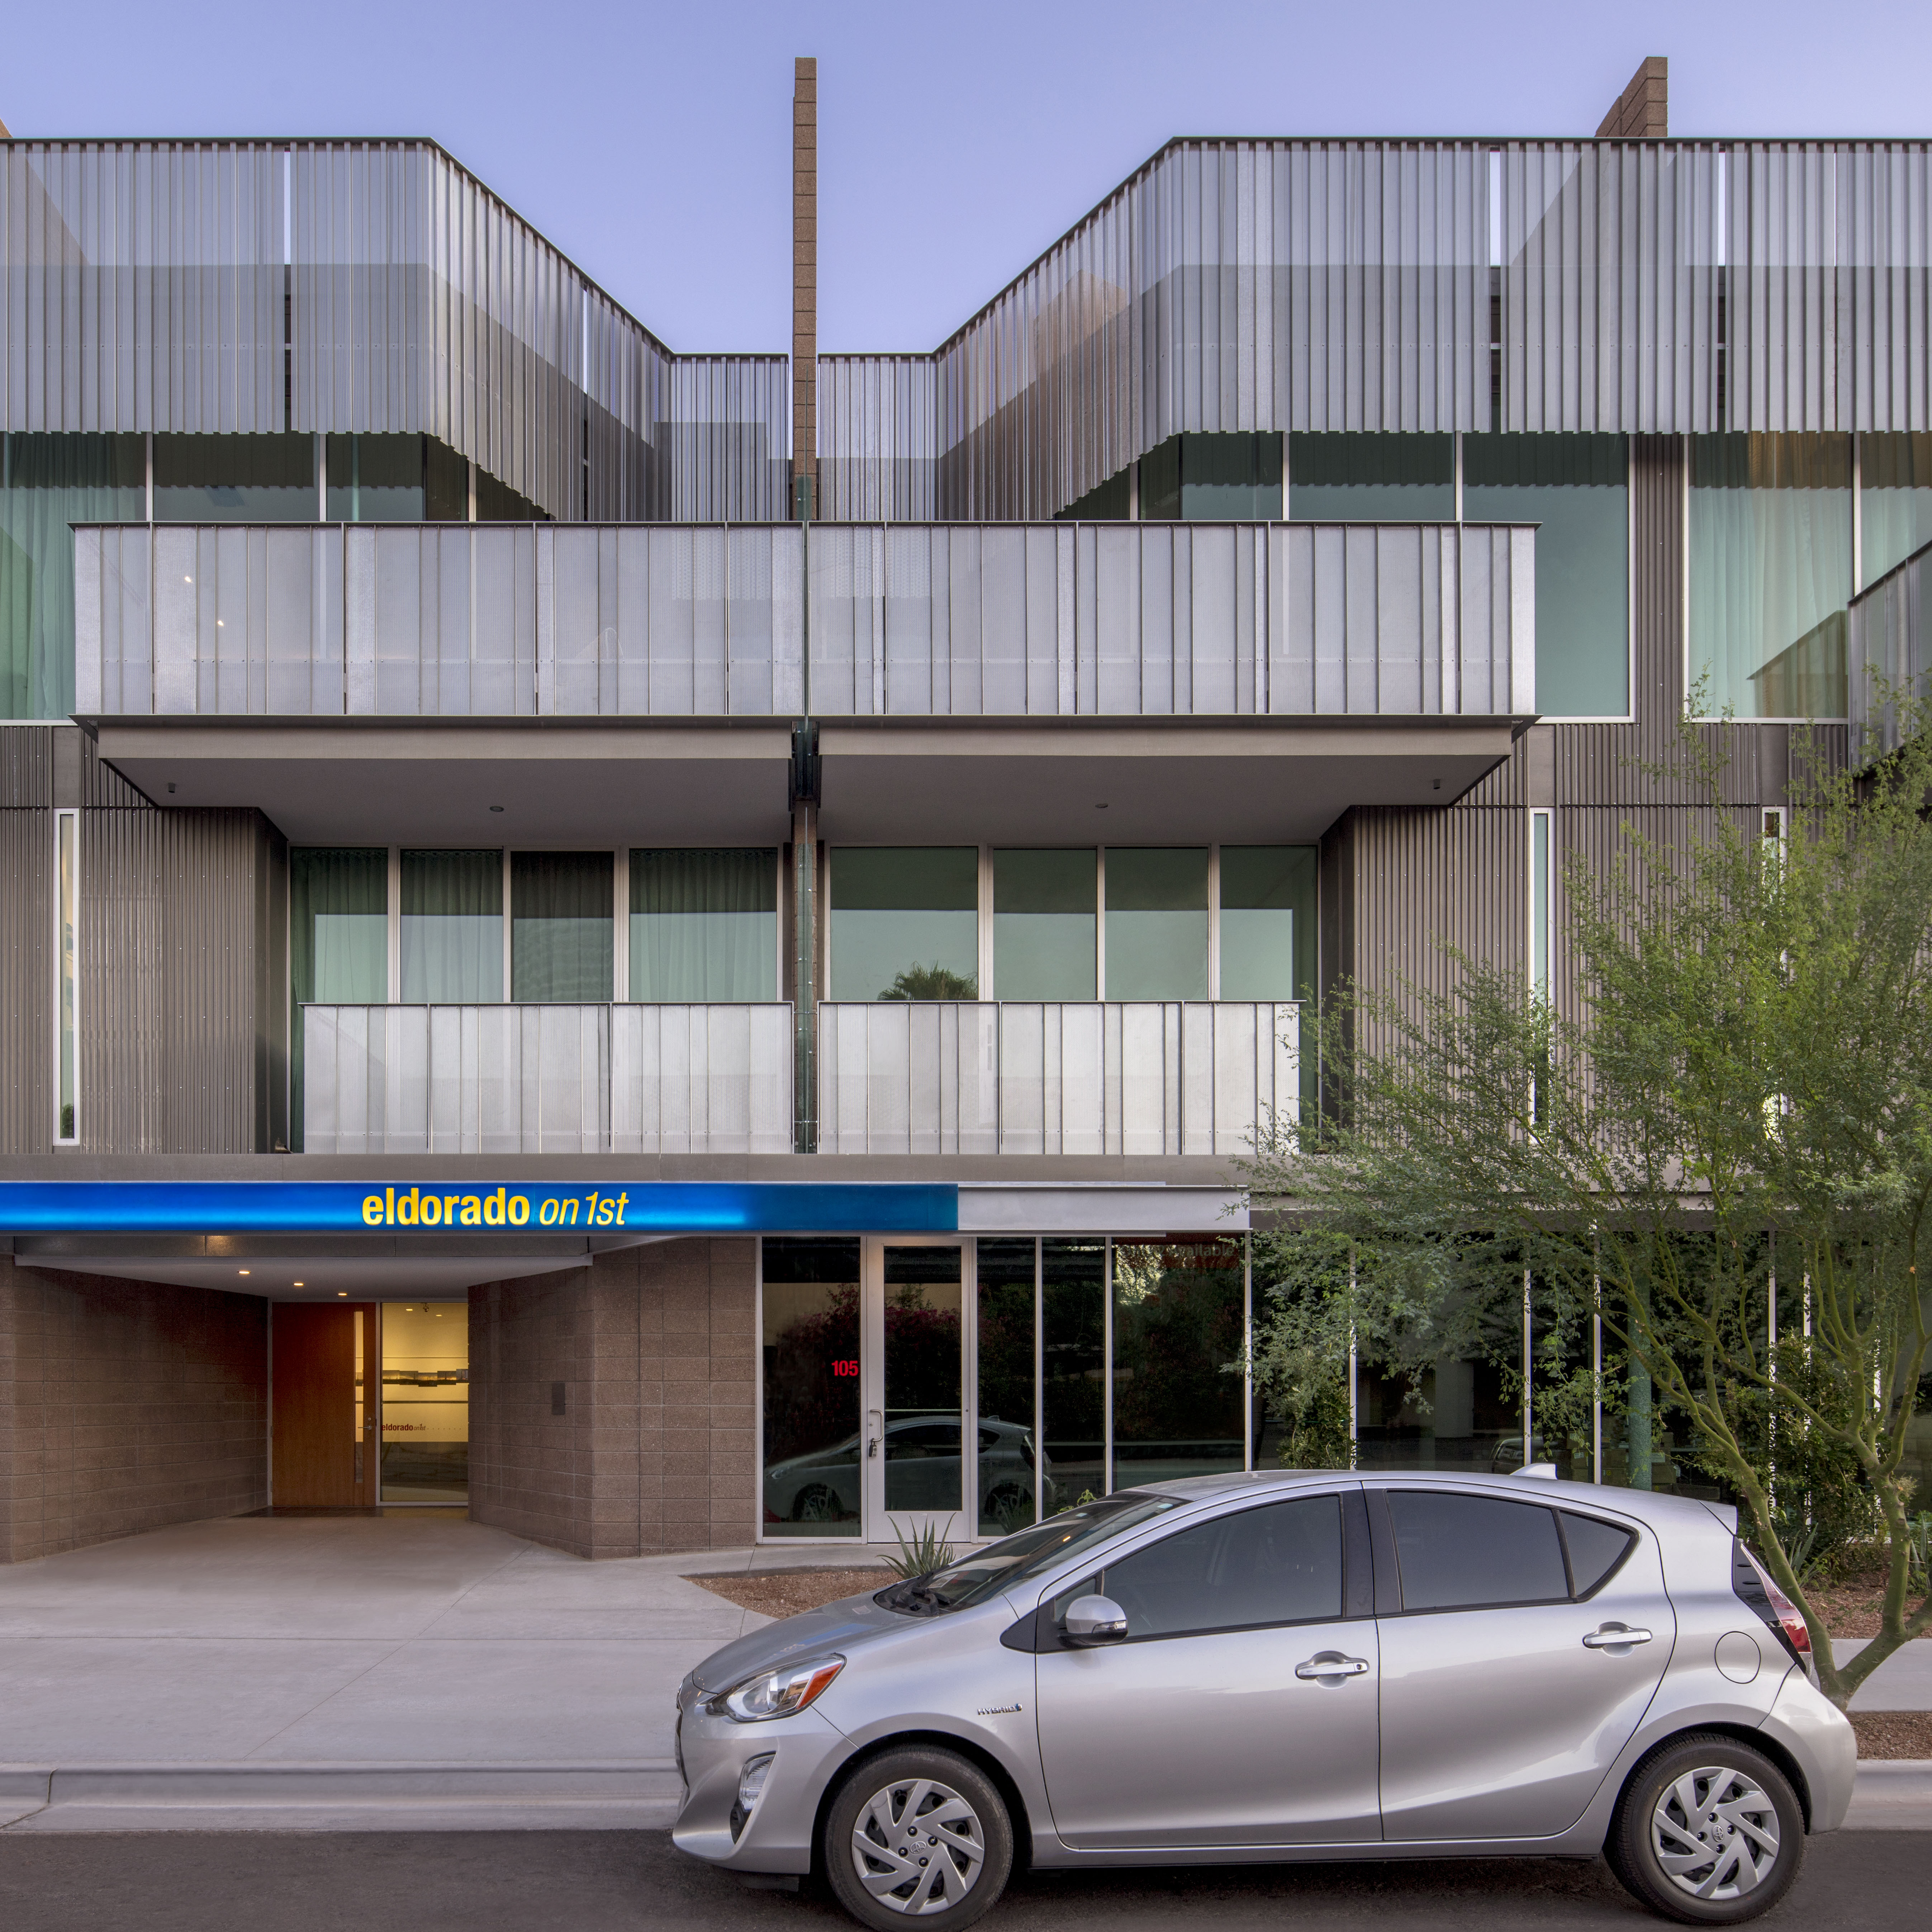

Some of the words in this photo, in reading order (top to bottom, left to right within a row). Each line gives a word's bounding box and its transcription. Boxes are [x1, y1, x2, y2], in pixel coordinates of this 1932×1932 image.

[362, 1188, 530, 1225] eldorado
[540, 1198, 579, 1225] on
[585, 1192, 629, 1225] 1st
[1168, 1243, 1234, 1256] Available
[831, 1360, 859, 1376] 105
[978, 1705, 1015, 1715] HYBRID
